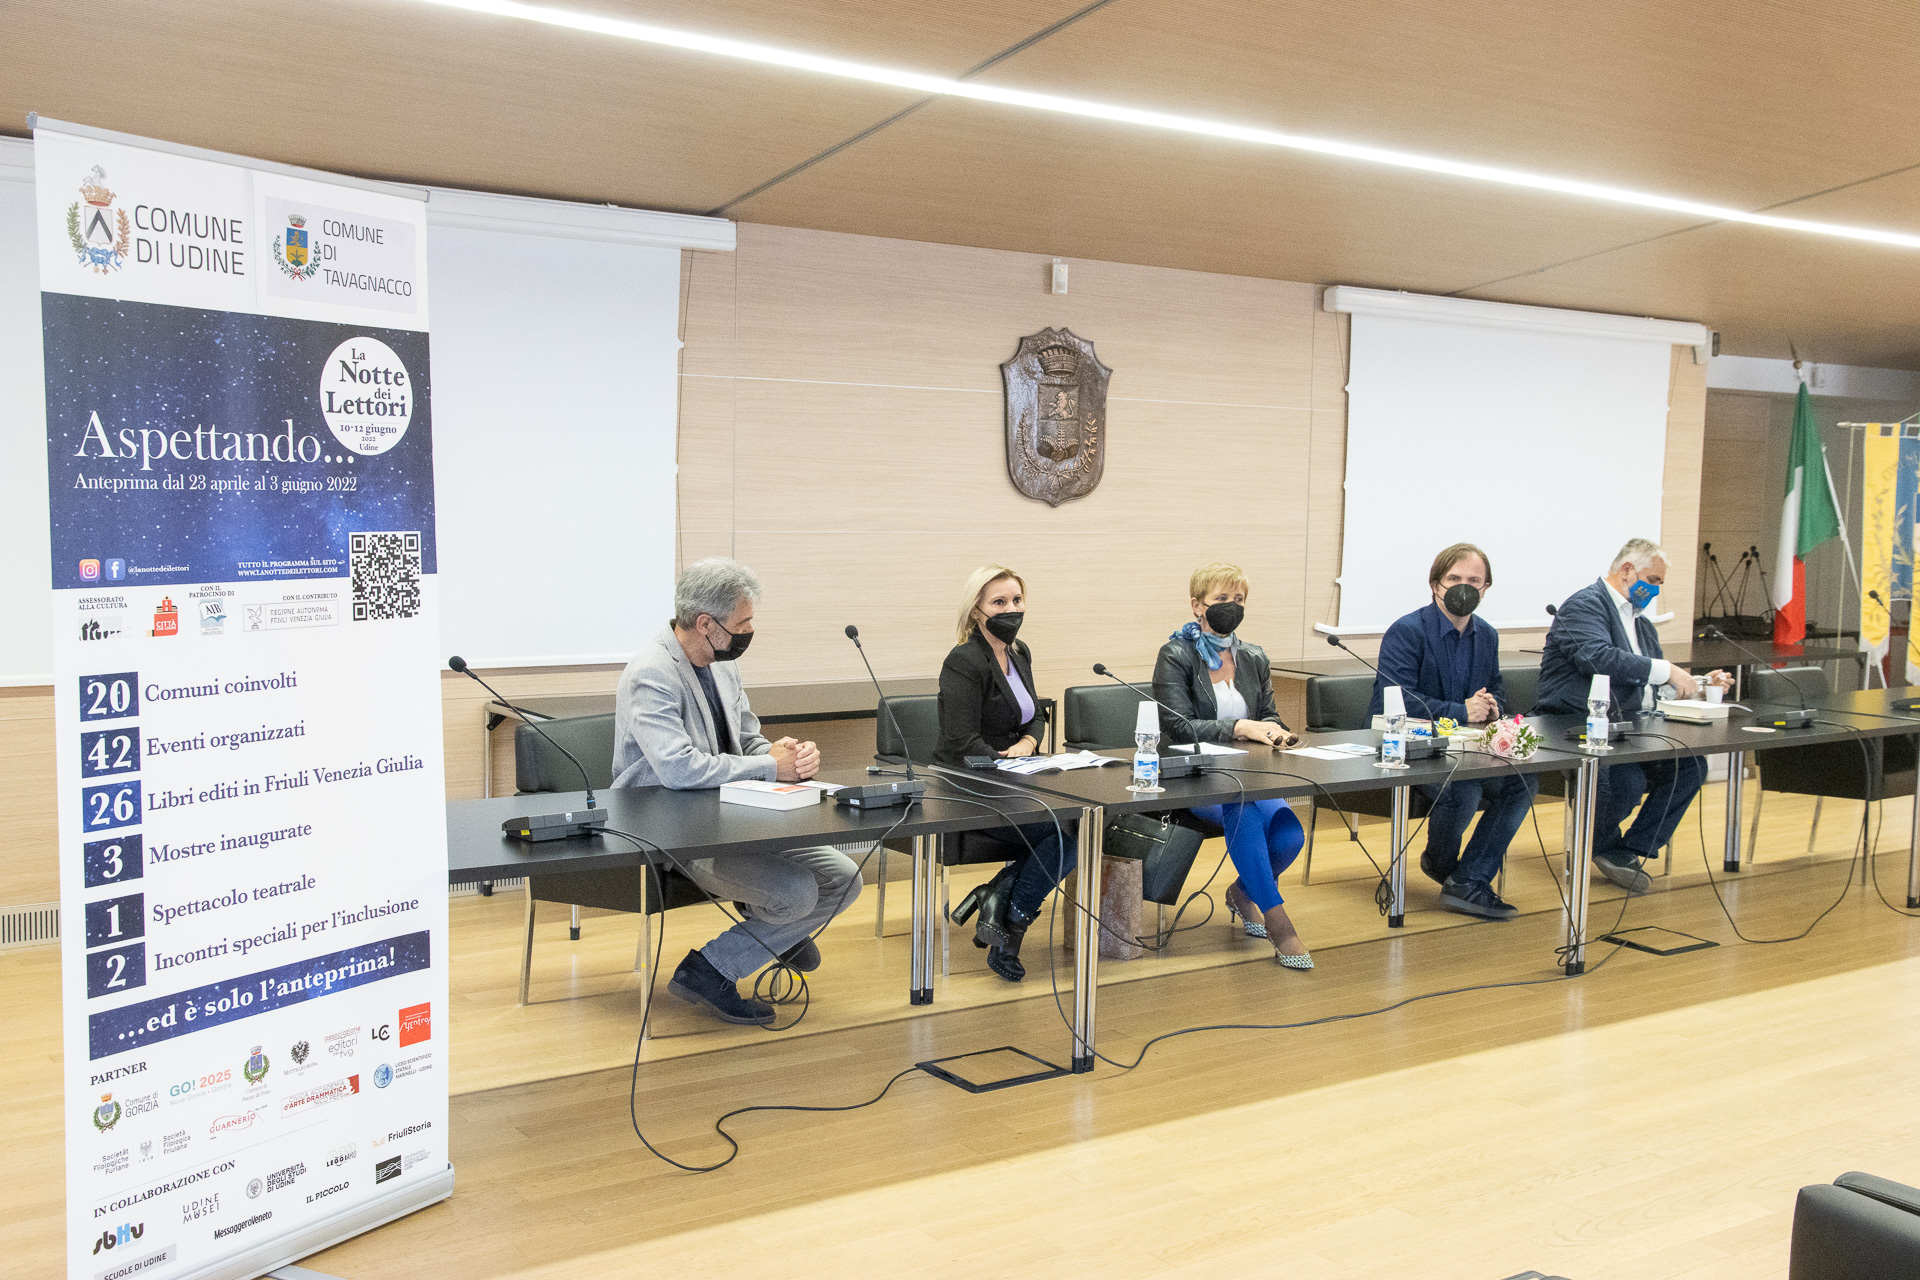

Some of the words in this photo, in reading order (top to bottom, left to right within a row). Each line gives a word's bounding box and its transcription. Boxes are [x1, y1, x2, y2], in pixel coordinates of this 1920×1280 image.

[134, 204, 244, 244] COMUNE
[322, 218, 384, 246] COMUNE
[136, 237, 160, 266] DI
[170, 244, 244, 276] UDINE
[324, 244, 337, 262] DI
[324, 268, 412, 298] TAVAGNACCO
[352, 348, 366, 360] La
[339, 360, 405, 386] Notte
[374, 388, 391, 400] dei
[325, 390, 408, 418] Lettori
[366, 424, 397, 436] giugno
[74, 410, 355, 471] Aspettando...
[74, 473, 159, 493] Anteprima
[162, 474, 185, 491] dal
[188, 475, 207, 491] 23
[210, 474, 250, 495] aprile
[254, 475, 266, 491] al
[270, 476, 278, 492] 3
[281, 476, 323, 495] giugno
[326, 476, 357, 492] 2022
[128, 564, 190, 574] @lanottedeilettori
[238, 567, 338, 576] WWW.LANOTTEDEILETTORI.COM
[204, 604, 222, 615] AIB
[270, 608, 294, 616] REGIONE
[156, 619, 176, 627] CITTÀ
[86, 679, 131, 715] 20
[144, 678, 220, 702] Comuni
[224, 670, 298, 694] coinvolti
[88, 735, 132, 771] 42
[146, 731, 206, 756] Eventi
[210, 720, 306, 751] organizzati
[90, 788, 134, 826] 26
[148, 788, 194, 812] Libri
[199, 780, 239, 803] editi
[243, 779, 261, 797] in
[264, 770, 310, 794] Friuli
[312, 760, 373, 784] Venezia
[376, 755, 424, 775] Giulia
[102, 844, 124, 879] 3
[149, 841, 216, 865] Mostre
[220, 823, 312, 851] inaugurate
[106, 904, 123, 938] 1
[153, 889, 248, 925] Spettacolo
[252, 875, 316, 902] teatrale
[106, 954, 126, 989] 2
[154, 938, 228, 972] Incontri
[232, 922, 297, 956] speciali
[301, 917, 328, 940] per
[331, 897, 419, 928] l'inclusione
[118, 1004, 177, 1040] ...ed
[184, 1002, 198, 1023] è
[204, 987, 254, 1018] solo
[260, 946, 396, 1003] l'anteprima!
[325, 1026, 361, 1042] associazione
[328, 1035, 358, 1052] editori
[340, 1049, 353, 1058] fvg
[90, 1061, 148, 1086] PARTNER
[170, 1080, 196, 1097] GO!
[199, 1069, 232, 1088] 2025
[211, 1083, 232, 1094] Gorizia
[306, 1085, 347, 1103] DRAMMATICA
[310, 1081, 344, 1096] ACCADEMIA
[125, 1093, 151, 1108] Comune
[152, 1091, 158, 1100] di
[126, 1100, 159, 1118] GORIZIA
[313, 1097, 329, 1106] NICO
[209, 1113, 256, 1134] GUARNERIO
[388, 1121, 432, 1142] FriuliStoria
[163, 1130, 186, 1142] Società
[163, 1135, 191, 1149] Filologica
[163, 1143, 188, 1156] Friulana
[105, 1163, 129, 1175] Furlane
[266, 1161, 304, 1181] UNIVERSITÀ
[267, 1175, 287, 1187] DEGLI
[288, 1168, 306, 1179] STUDI
[94, 1206, 107, 1218] IN
[109, 1169, 210, 1212] COLLABORAZIONE
[212, 1160, 236, 1174] CON
[276, 1178, 295, 1190] UDINE
[315, 1181, 350, 1200] PICCOLO
[182, 1193, 219, 1214] UDINE
[182, 1203, 220, 1224] MUSEI
[214, 1211, 272, 1240] MessaggeroVeneto
[104, 1266, 133, 1280] SCUOLE
[134, 1262, 142, 1271] DI
[144, 1253, 167, 1268] UDINE
